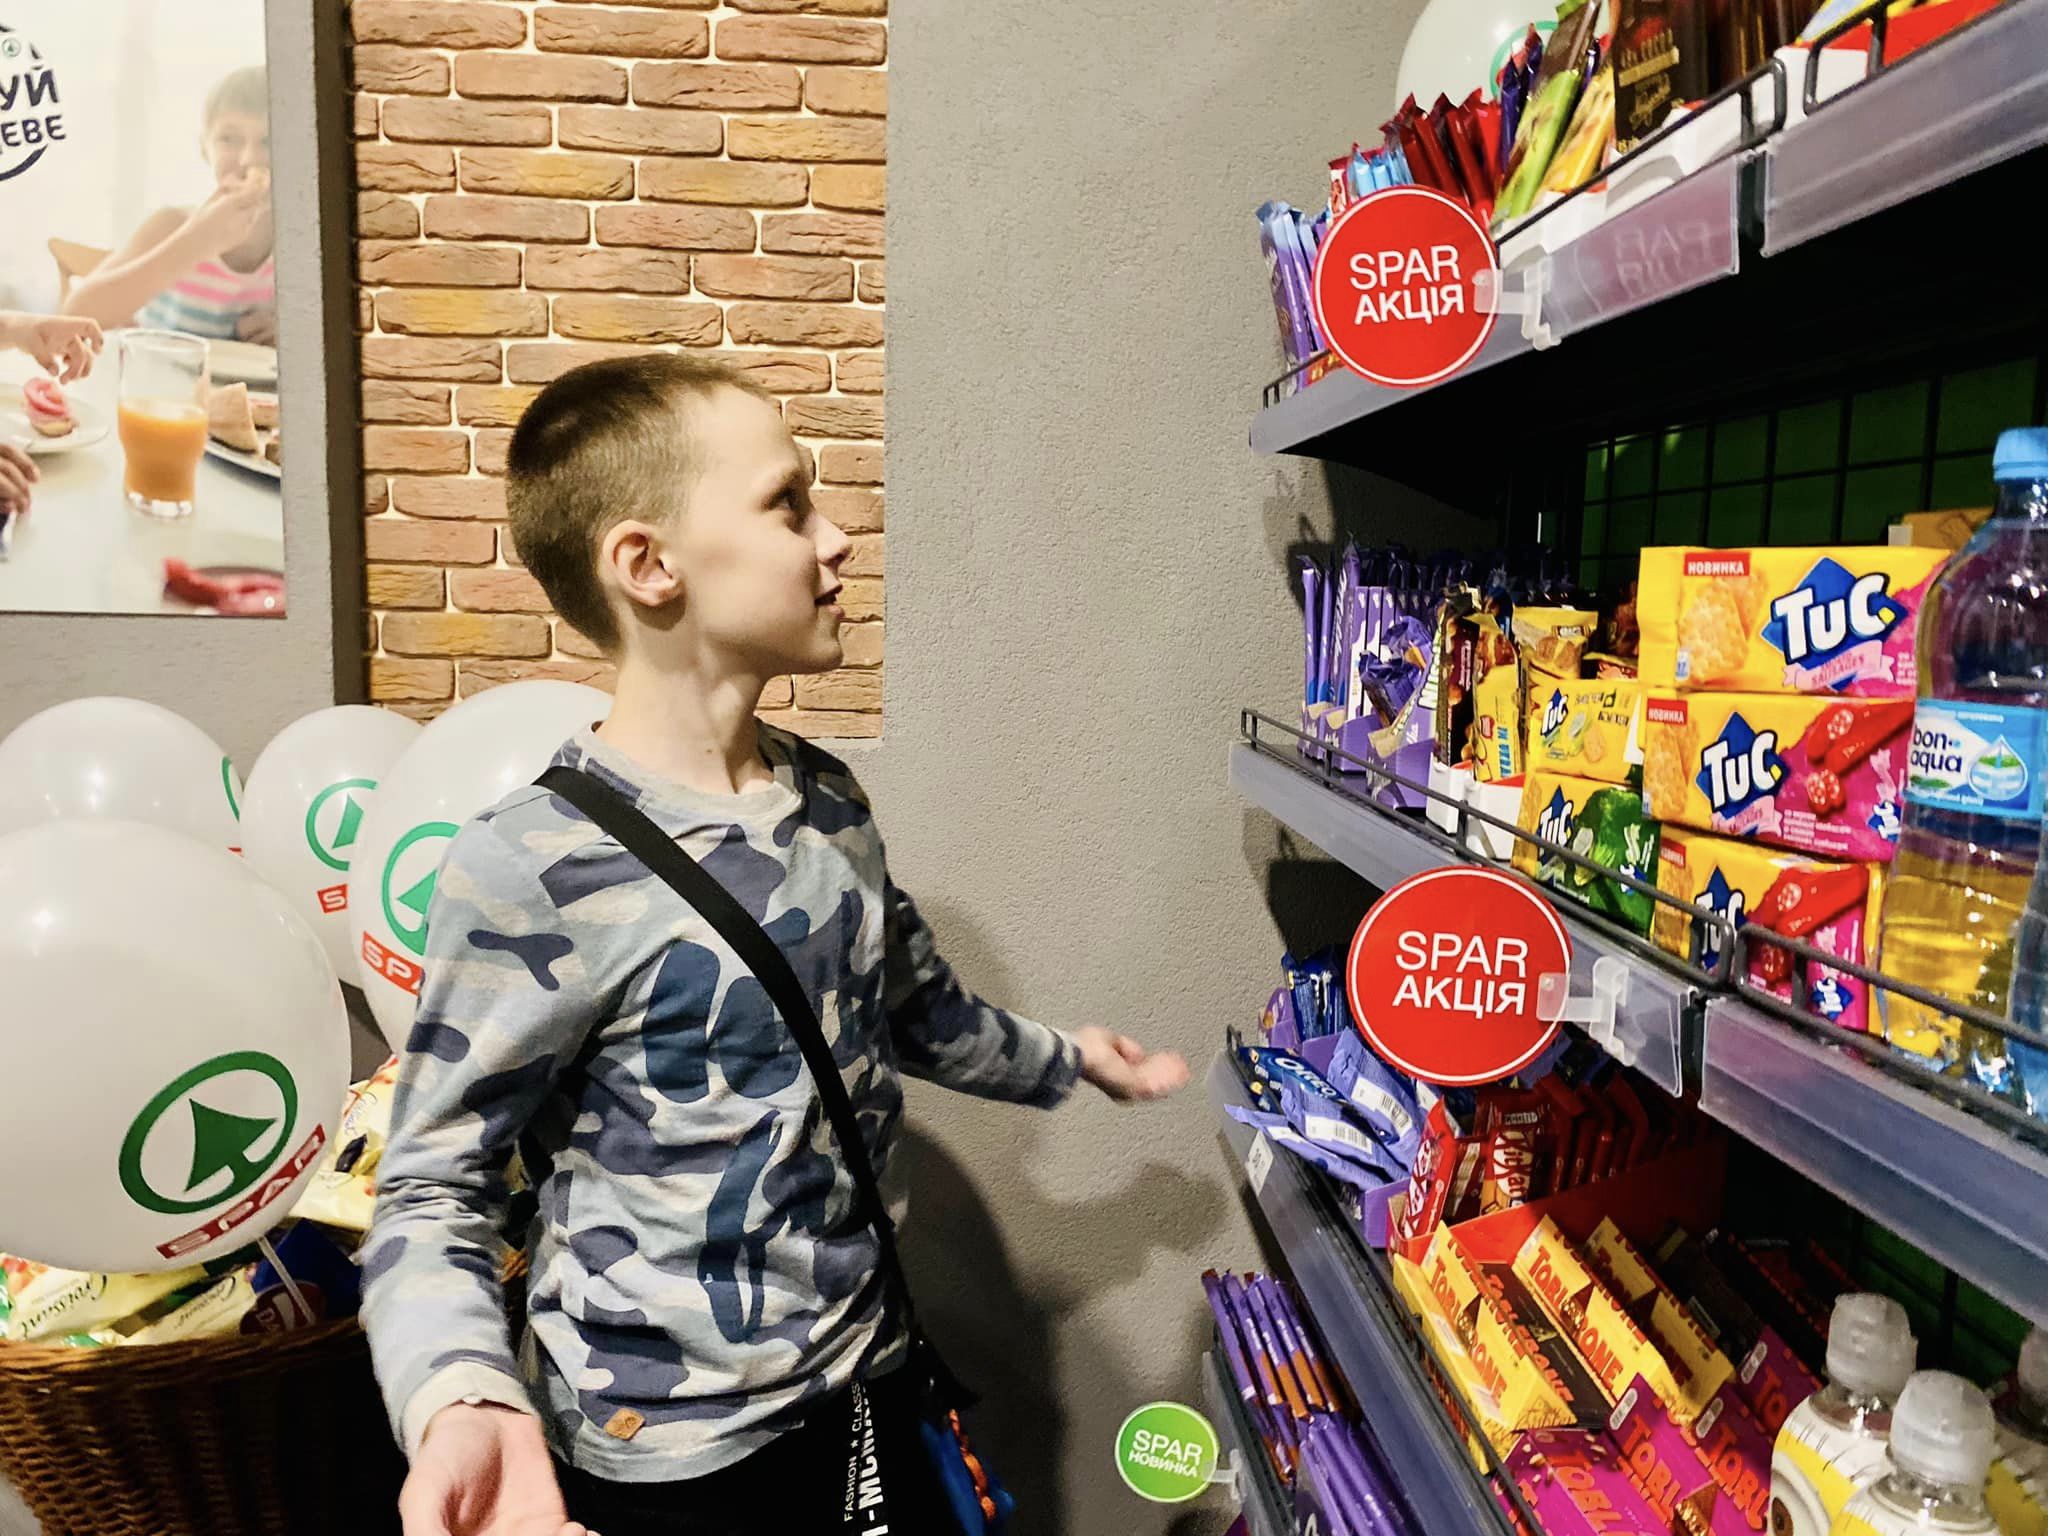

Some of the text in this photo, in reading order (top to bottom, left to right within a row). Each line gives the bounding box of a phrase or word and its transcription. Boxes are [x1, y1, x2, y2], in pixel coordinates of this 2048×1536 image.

[0, 114, 67, 147] ЕВЕ
[1349, 244, 1461, 291] SPAR
[1354, 283, 1465, 326] АКЦІЯ
[1687, 561, 1745, 575] НОВИНКА
[1910, 749, 1963, 774] aqua
[364, 938, 422, 991] SP
[1394, 930, 1530, 979] SPAR
[1391, 974, 1527, 1020] АКЦІЯ
[843, 1382, 863, 1522] FASHION CLASS
[1127, 1450, 1199, 1479] НОВИНКА
[1131, 1428, 1204, 1465] SPAR
